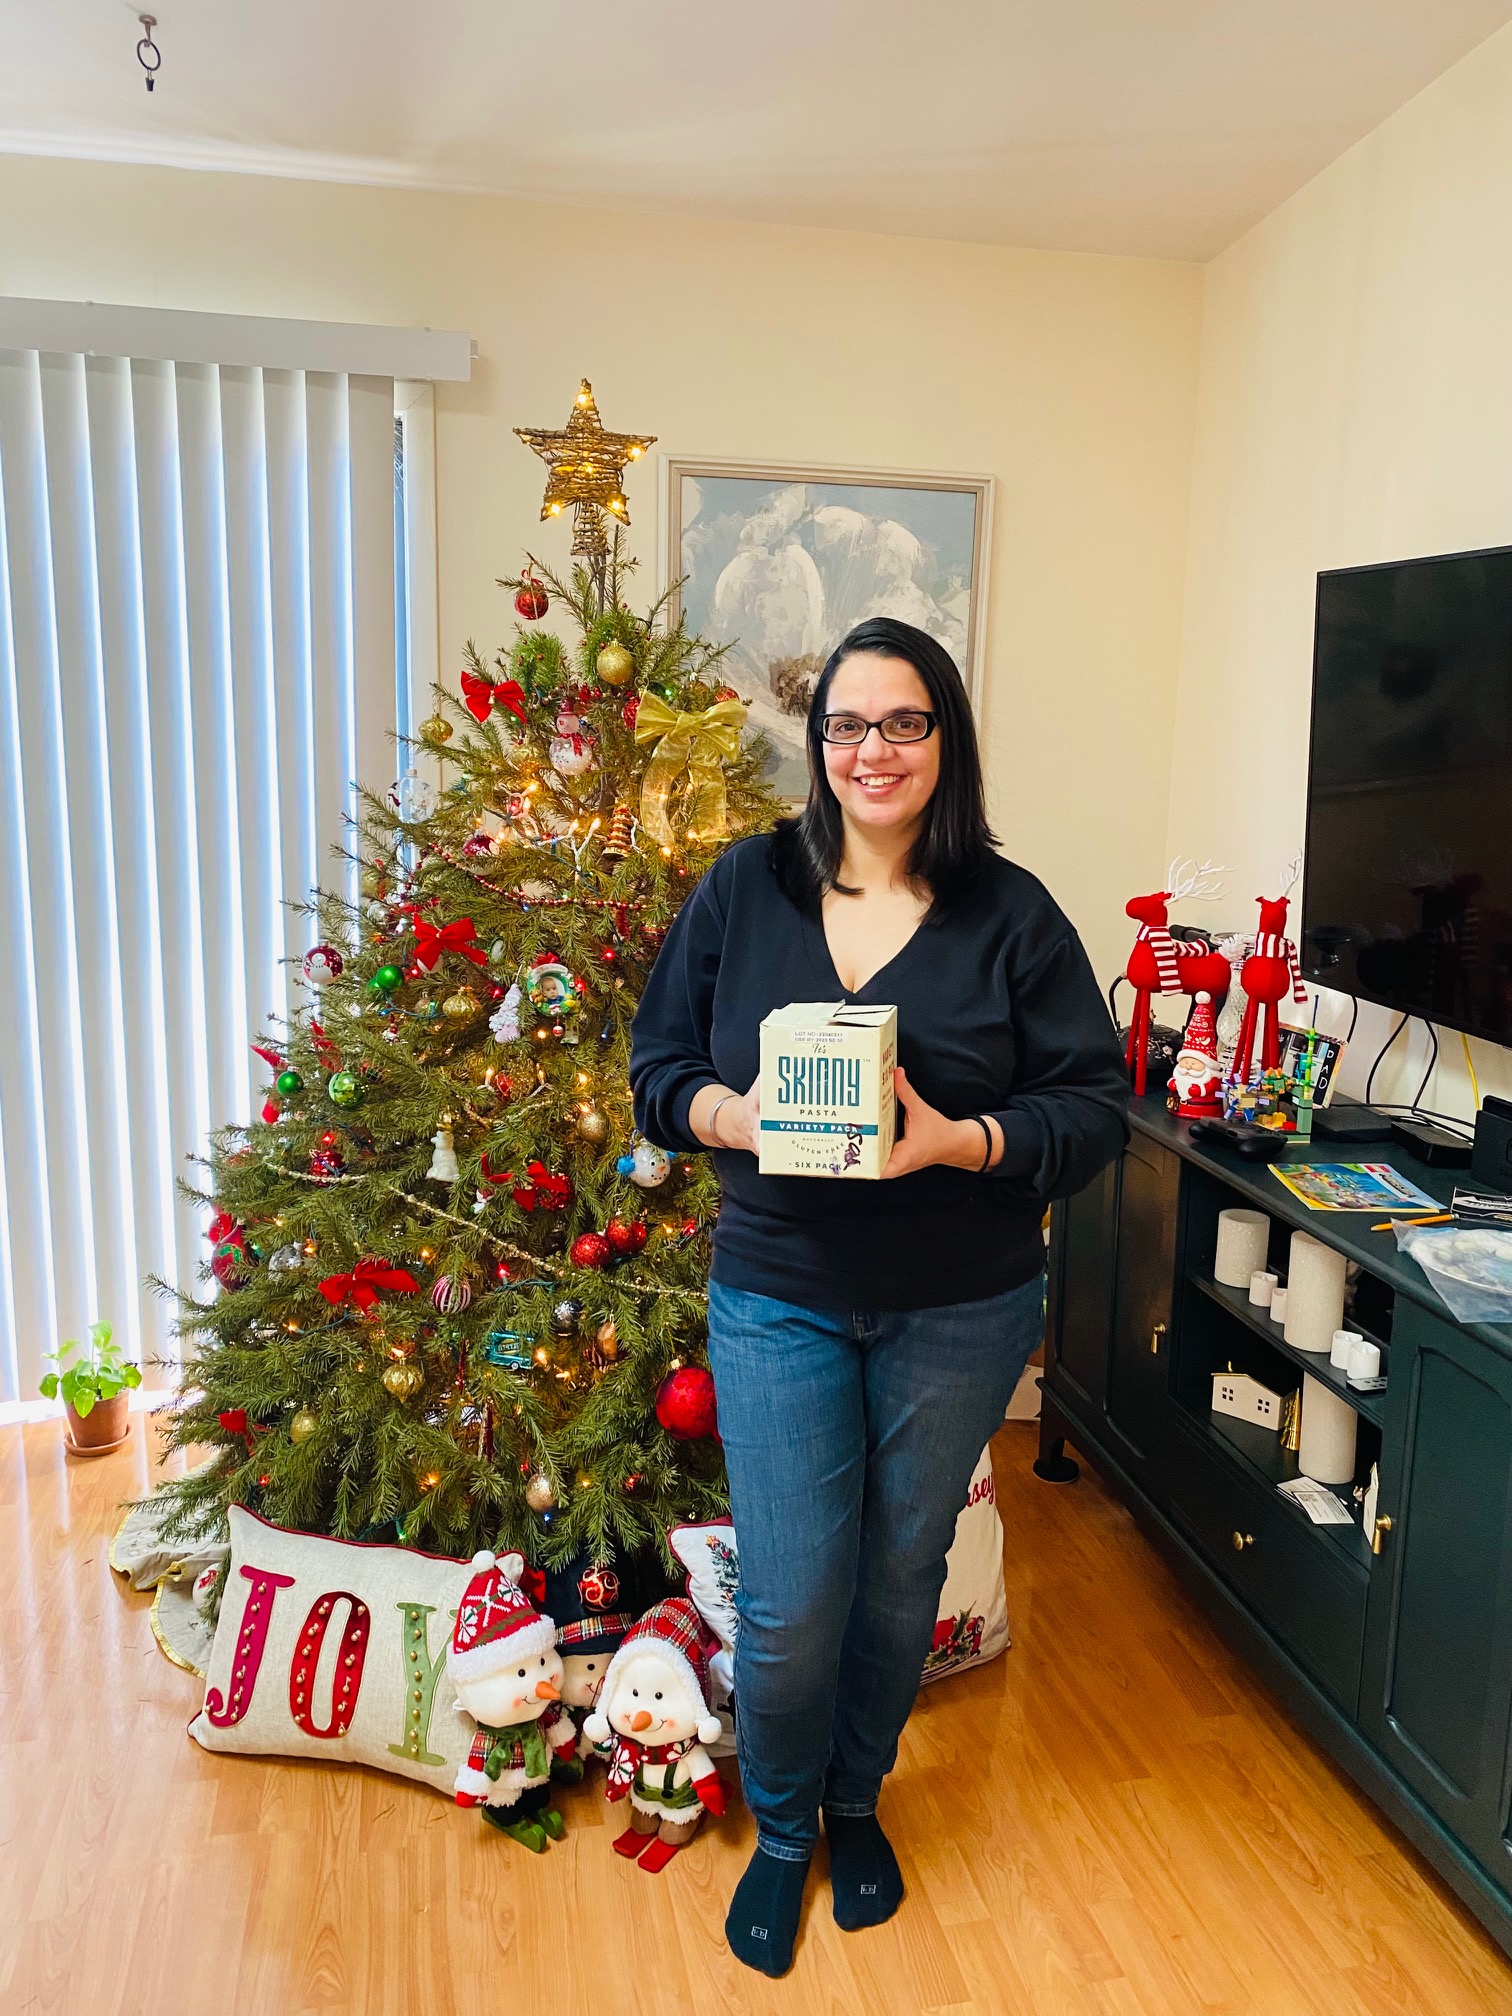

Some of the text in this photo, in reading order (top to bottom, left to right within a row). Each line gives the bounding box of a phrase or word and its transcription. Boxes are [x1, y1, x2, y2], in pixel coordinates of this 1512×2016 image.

[812, 1043, 827, 1054] It's
[778, 1056, 860, 1106] SKINNY
[799, 1109, 837, 1117] PASTA
[779, 1123, 858, 1133] VARIETY PACK
[791, 1140, 844, 1154] GLUTEN FREE
[795, 1161, 842, 1170] SIX PACK
[205, 1564, 458, 1766] JOY
